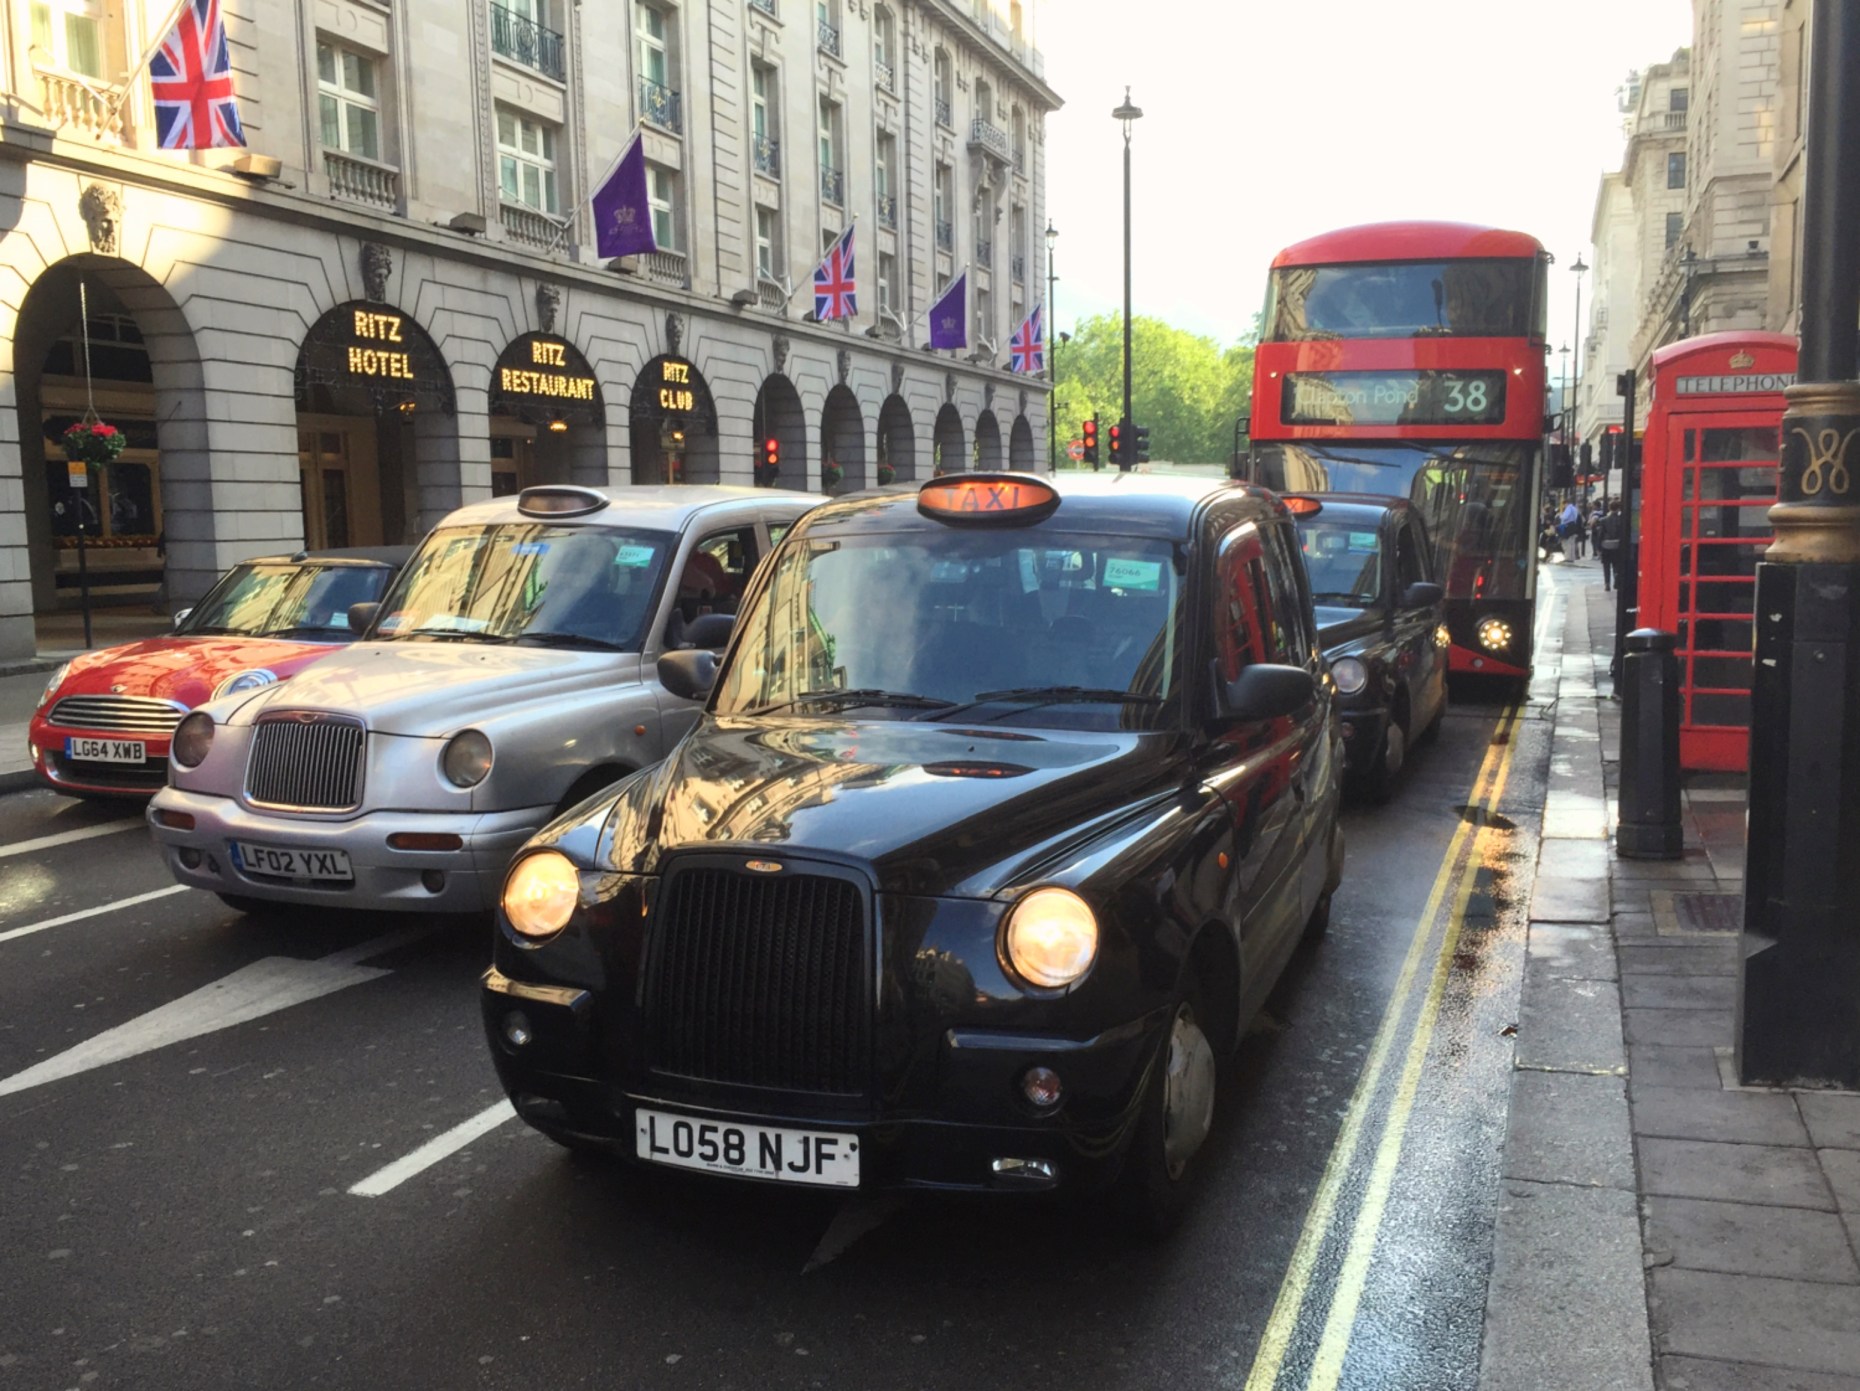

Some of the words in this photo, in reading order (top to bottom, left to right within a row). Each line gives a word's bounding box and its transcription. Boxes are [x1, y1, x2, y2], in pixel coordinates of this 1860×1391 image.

[353, 310, 403, 343] RITZ
[347, 347, 414, 380] HOTEL
[531, 340, 566, 367] RITZ
[501, 367, 595, 401] RESTAURANT
[662, 361, 689, 384] RITZ
[659, 388, 694, 412] CLUB
[1374, 383, 1419, 404] Pond
[1443, 380, 1487, 413] 38
[943, 486, 1020, 512] TAXI
[72, 739, 109, 758] LG64
[112, 742, 143, 760] XWB
[241, 846, 297, 873] LF02
[299, 852, 348, 875] YXL
[648, 1115, 746, 1167] LO58
[758, 1131, 839, 1175] NJF
